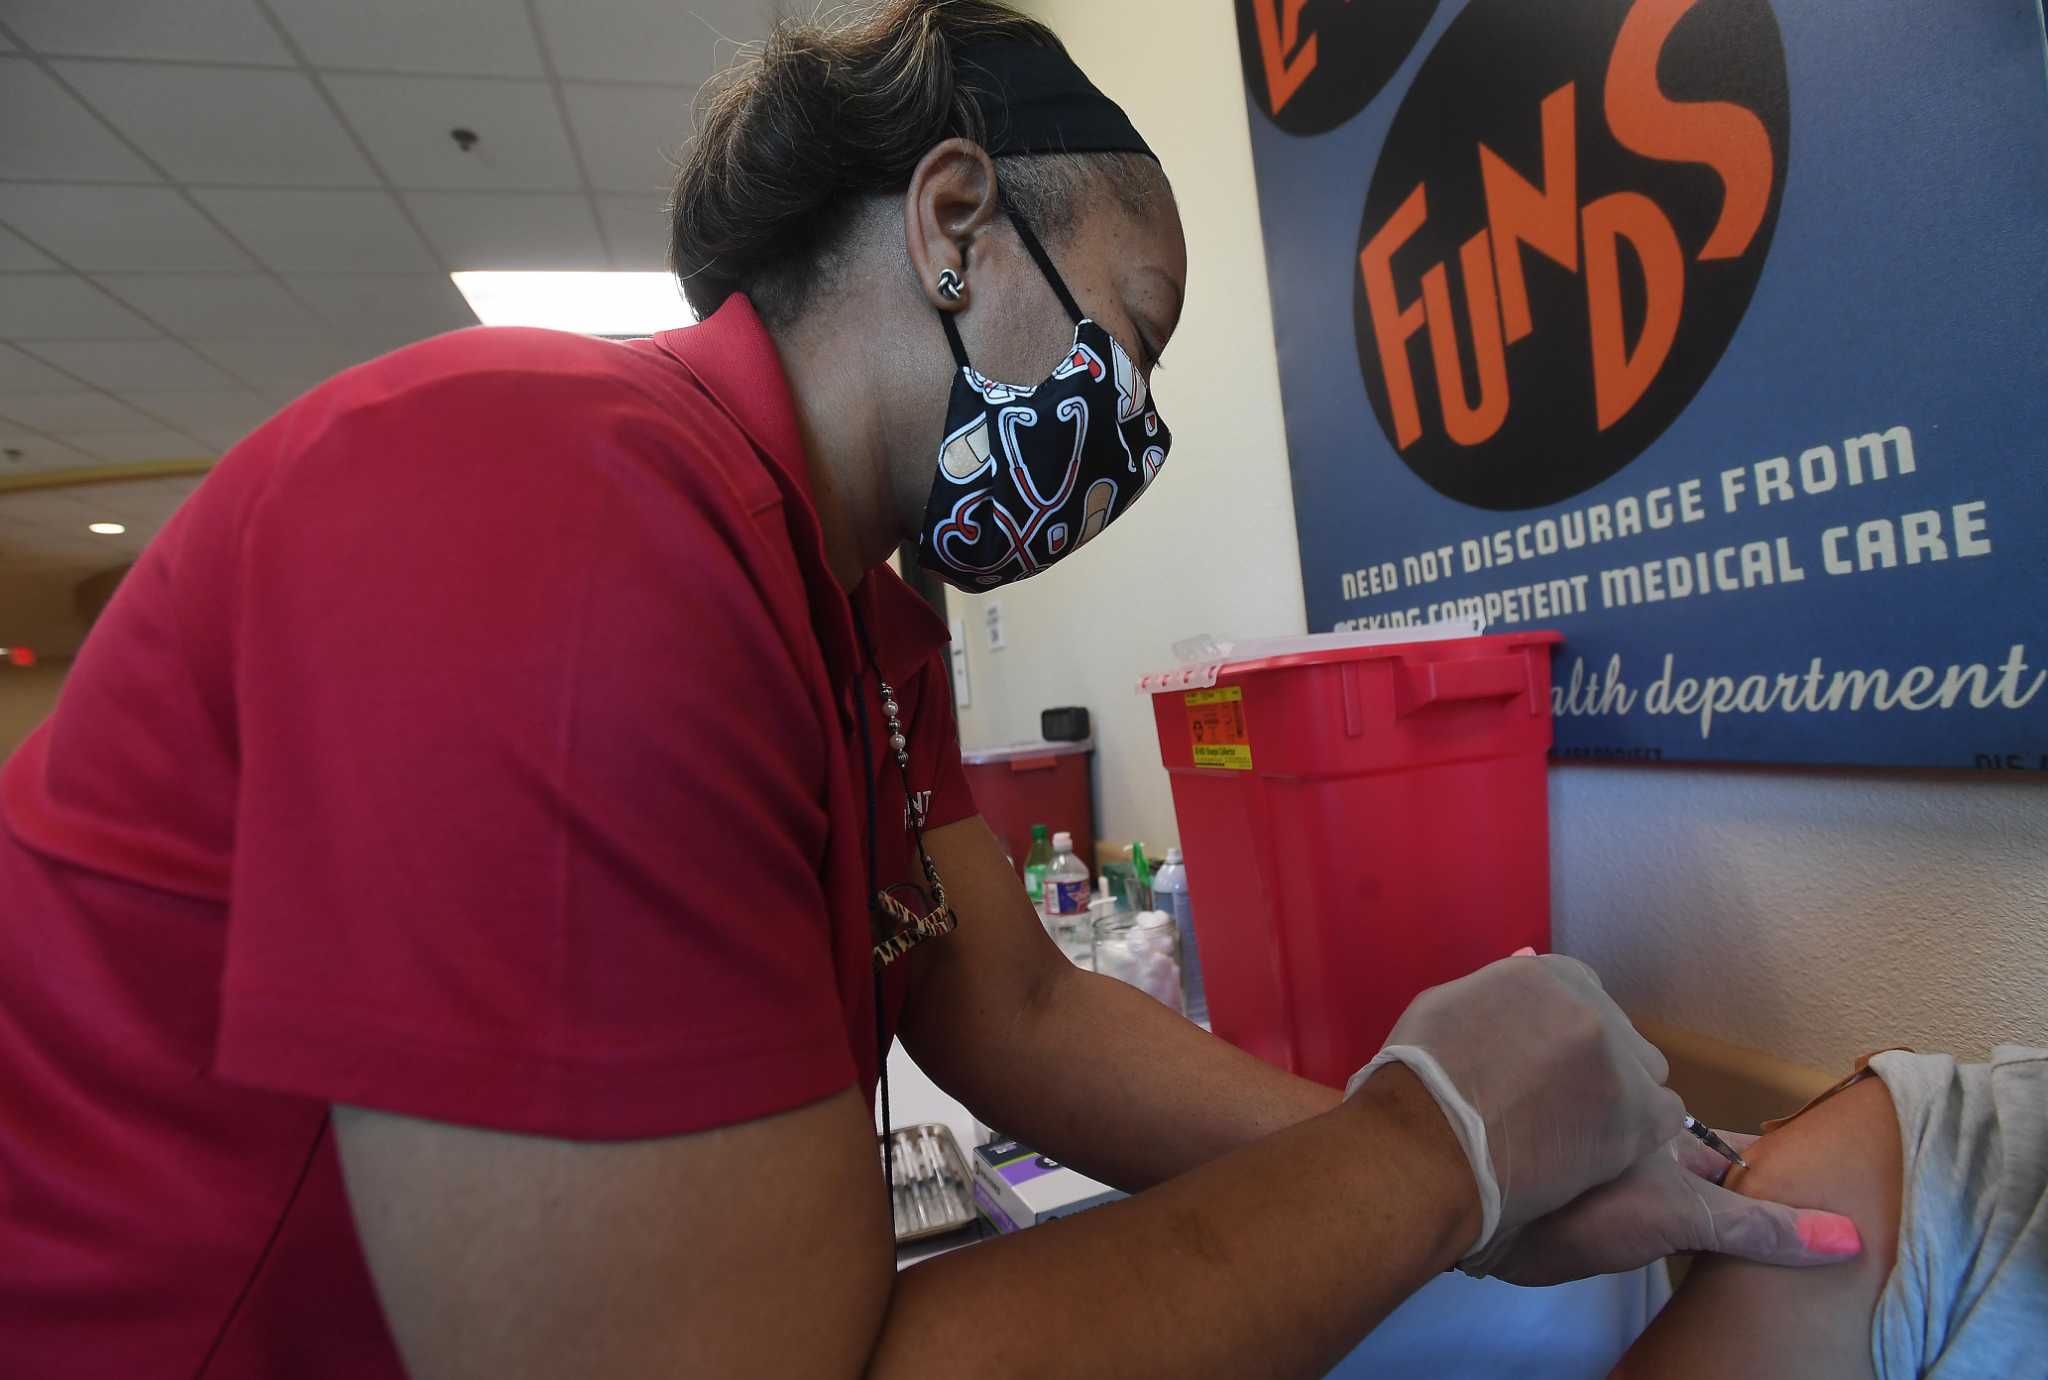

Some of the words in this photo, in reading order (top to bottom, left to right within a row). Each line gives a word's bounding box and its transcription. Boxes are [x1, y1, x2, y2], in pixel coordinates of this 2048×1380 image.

[1360, 0, 1774, 451] FUNDS
[1342, 562, 1398, 601] NEED
[1403, 546, 1454, 587] NOT
[1461, 479, 1704, 573] DISCOURAGE
[1721, 425, 1917, 514] FROM
[1428, 575, 1589, 626] COMPETENT
[1600, 537, 1805, 609] MEDICAL
[1821, 501, 1992, 576] CARE
[1645, 643, 2047, 740] department
